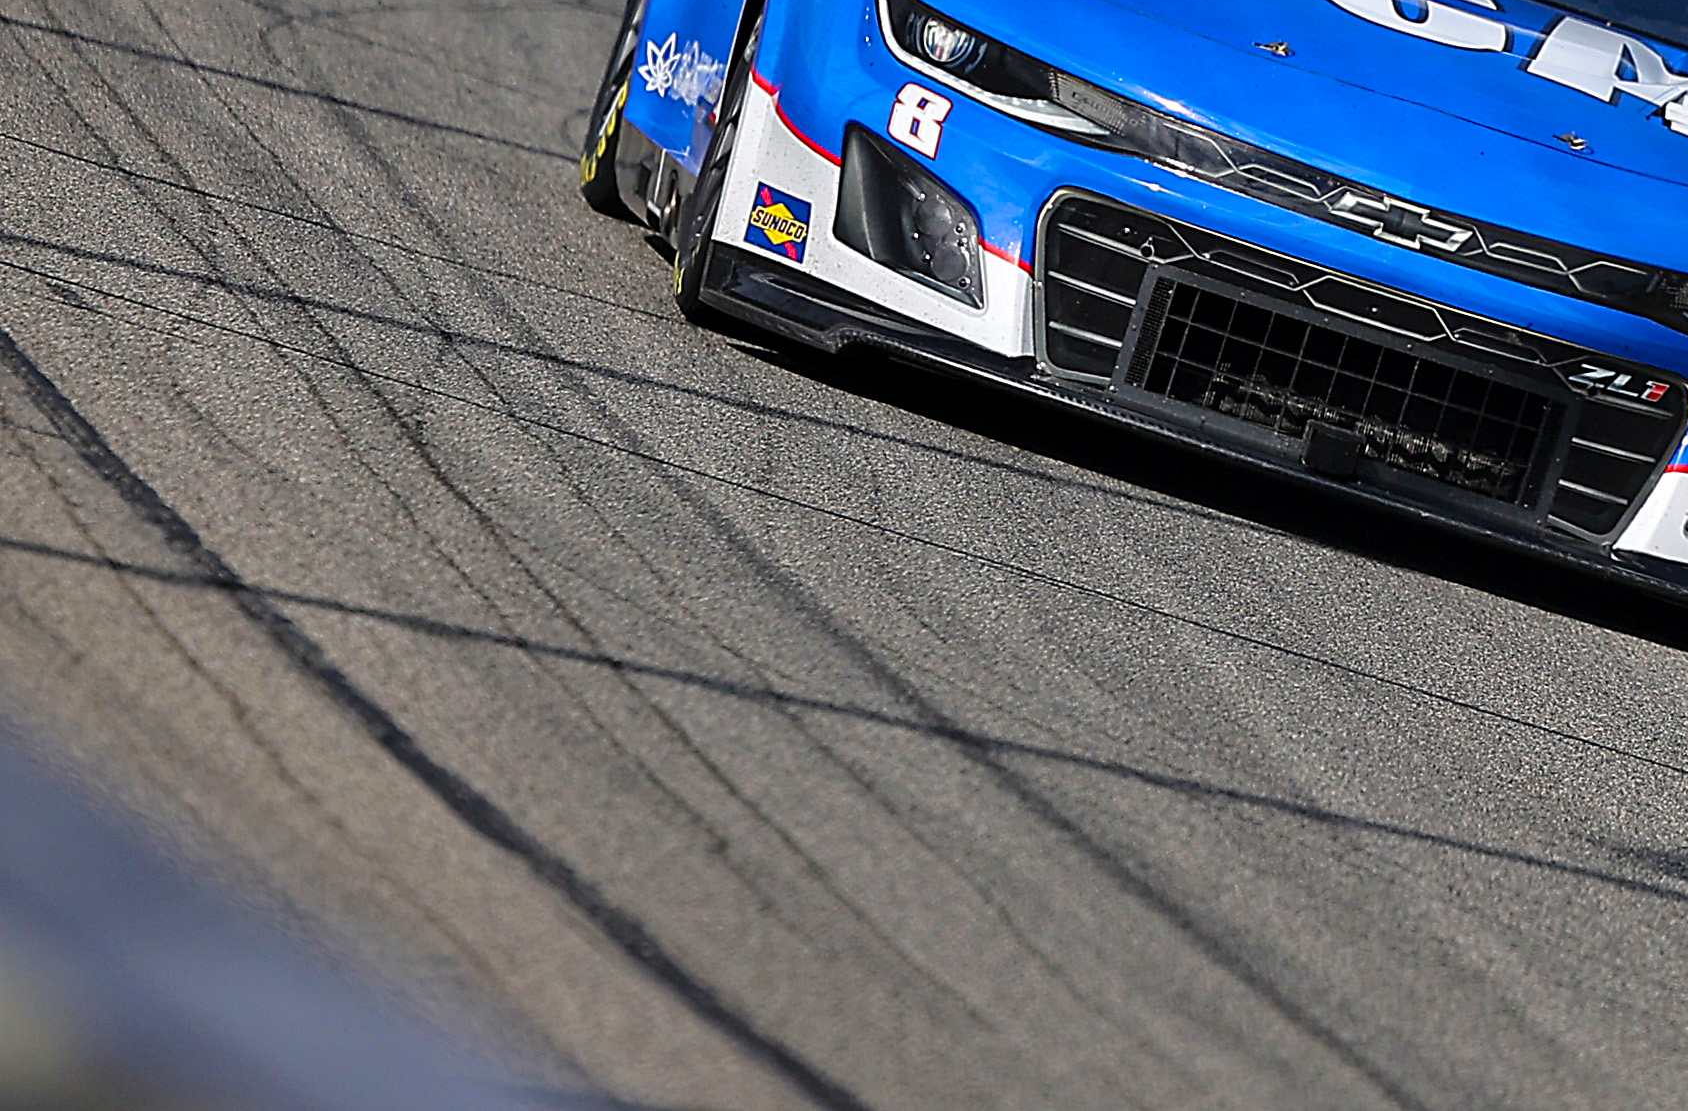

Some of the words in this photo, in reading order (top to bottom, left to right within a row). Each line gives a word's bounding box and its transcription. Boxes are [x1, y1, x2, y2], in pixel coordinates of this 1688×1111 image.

[888, 82, 953, 160] 8
[752, 208, 806, 241] SUNOCO
[1567, 363, 1671, 403] ZL1
